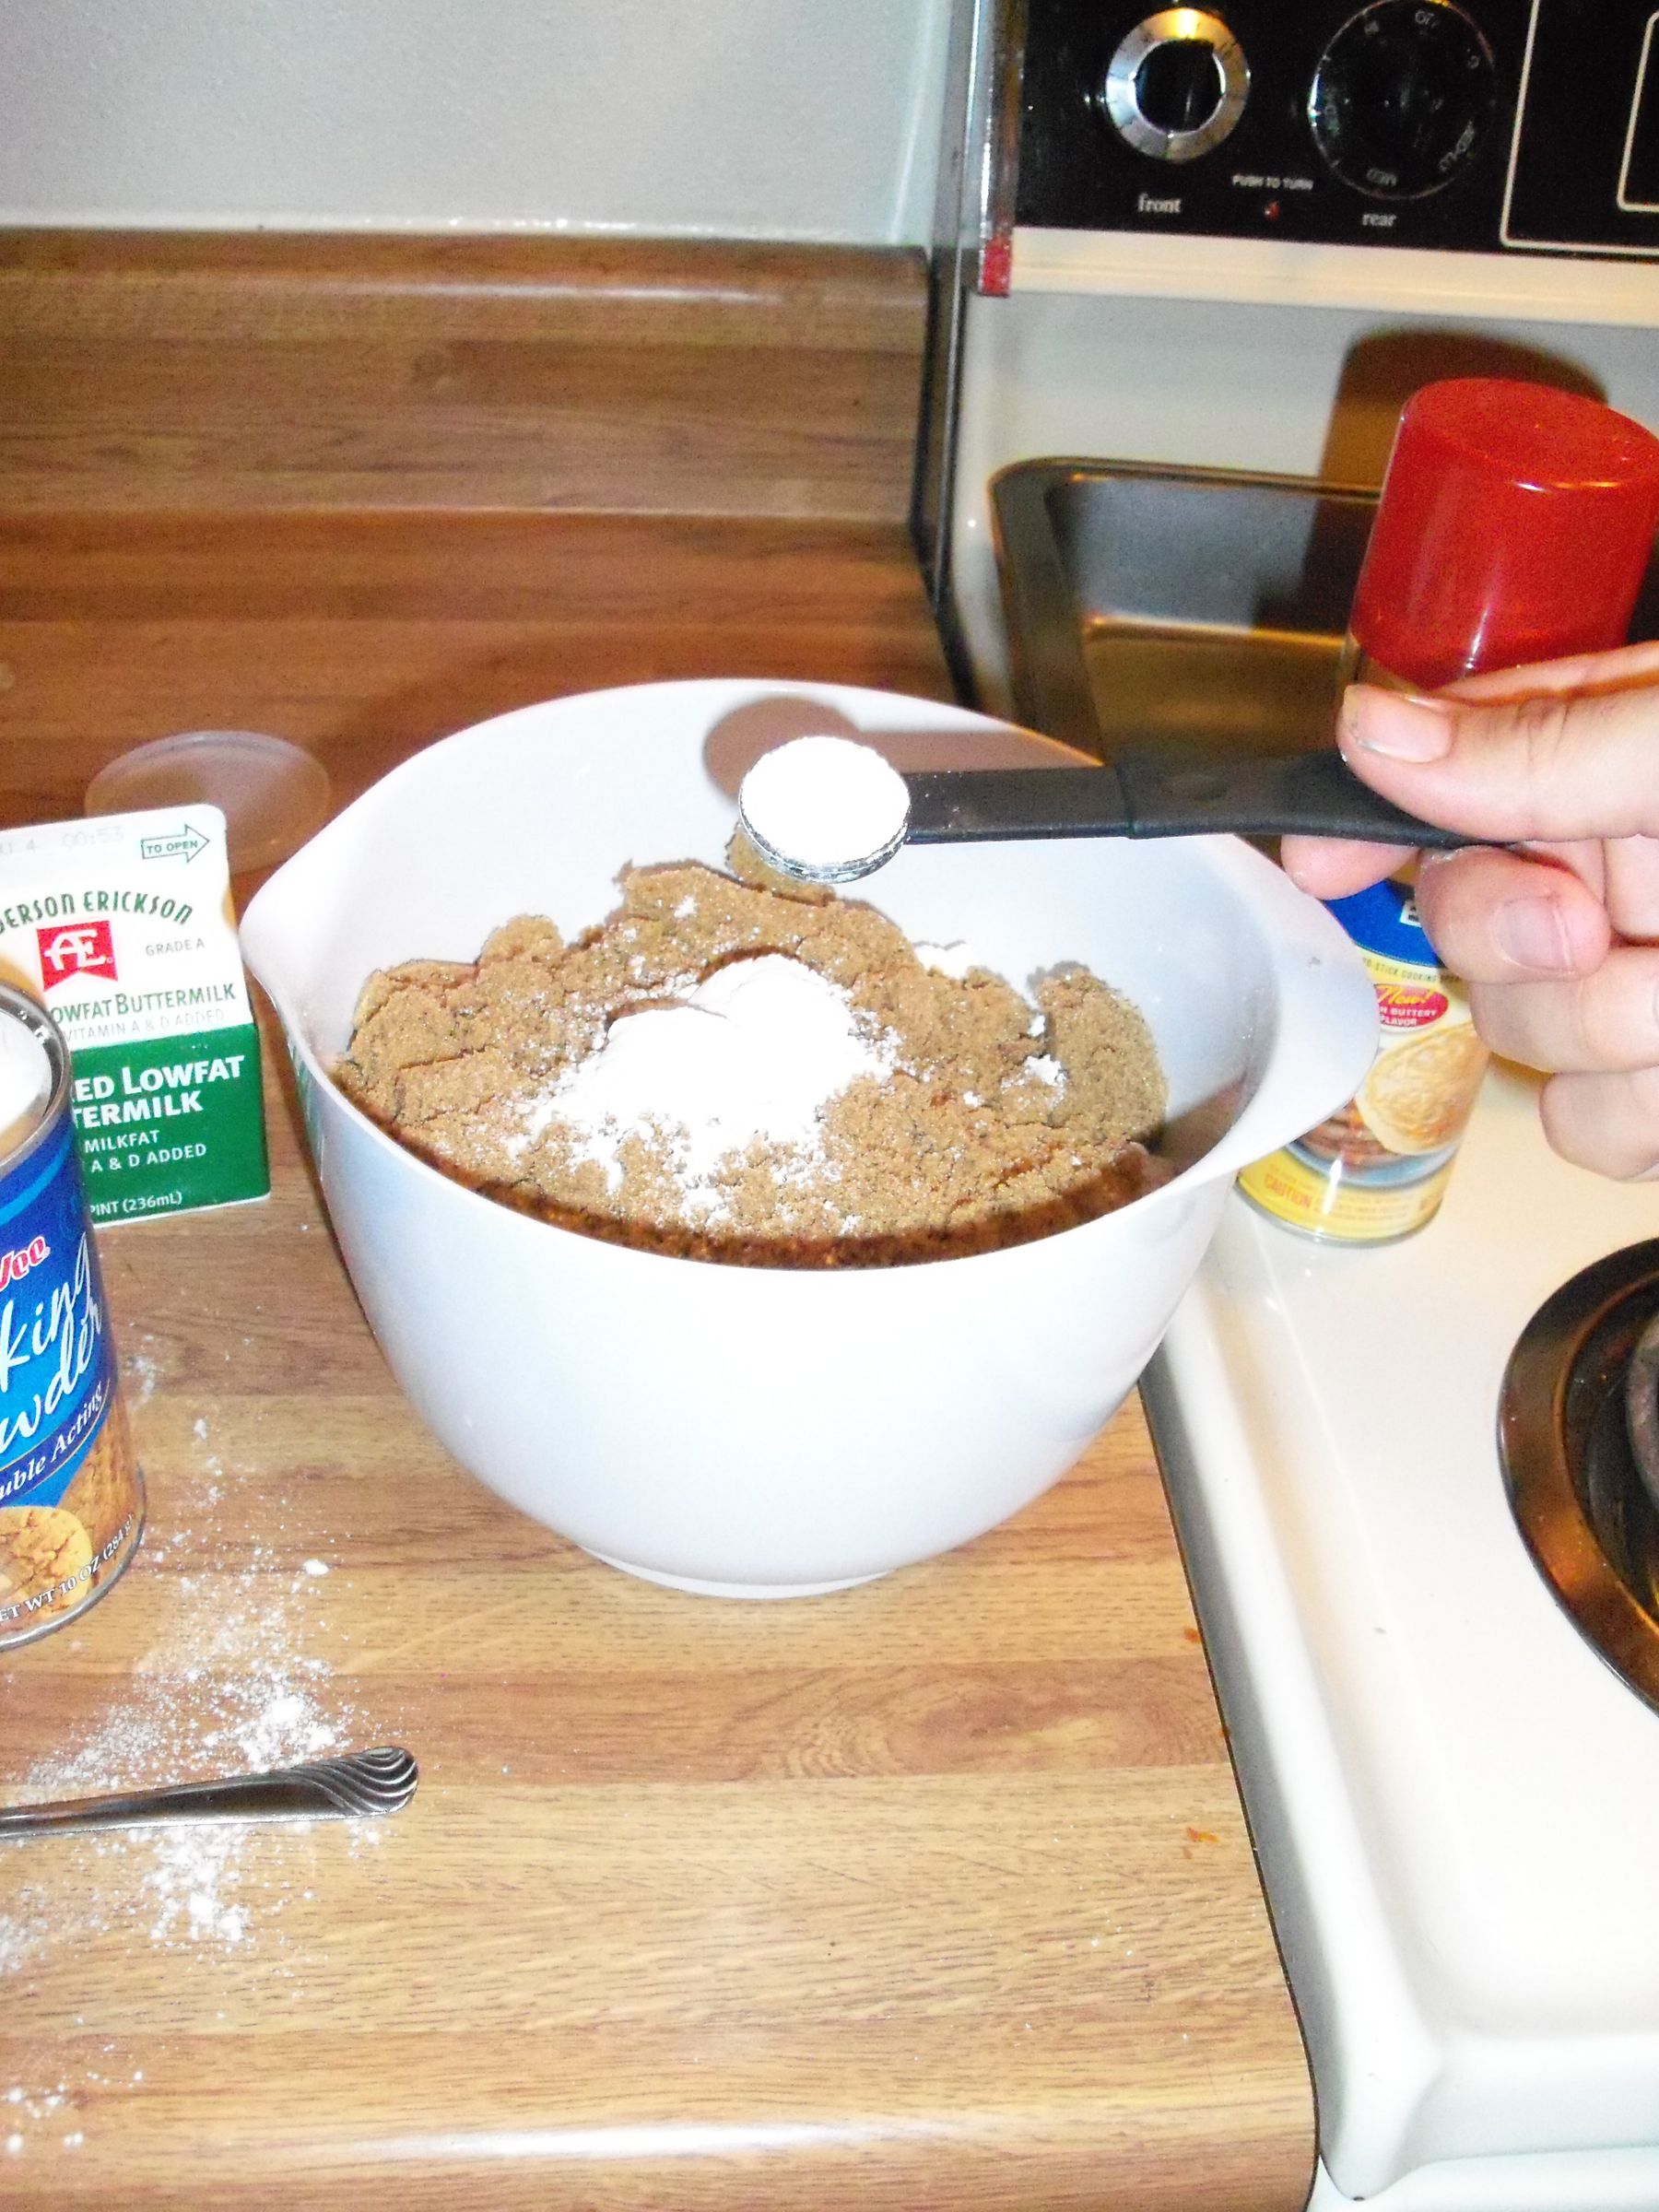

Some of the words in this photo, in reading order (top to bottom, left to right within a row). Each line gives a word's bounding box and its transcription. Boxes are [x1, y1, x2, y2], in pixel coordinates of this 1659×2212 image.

[1265, 176, 1281, 189] TO
[1137, 192, 1182, 214] front
[1361, 212, 1397, 228] rear
[147, 844, 162, 855] TO
[166, 840, 199, 853] OPEN
[83, 889, 194, 926] ERICKSON
[145, 941, 193, 957] GRADE
[195, 937, 206, 949] A
[49, 999, 113, 1024] OWFAT
[1391, 1007, 1437, 1018] BUTTERY
[66, 1022, 126, 1042] VITAMIN
[131, 1021, 141, 1033] A
[159, 1016, 171, 1030] D
[174, 1007, 225, 1025] ADDED
[84, 1129, 160, 1154] MILKFAT
[90, 1159, 103, 1173] A
[108, 1157, 123, 1171] &
[127, 1153, 141, 1168] D
[146, 1143, 207, 1166] ADDED
[122, 1191, 183, 1214] (236mL)
[51, 1382, 103, 1464] Acting
[25, 1587, 56, 1612] WT
[59, 1576, 77, 1596] 10
[79, 1557, 102, 1583] OZ
